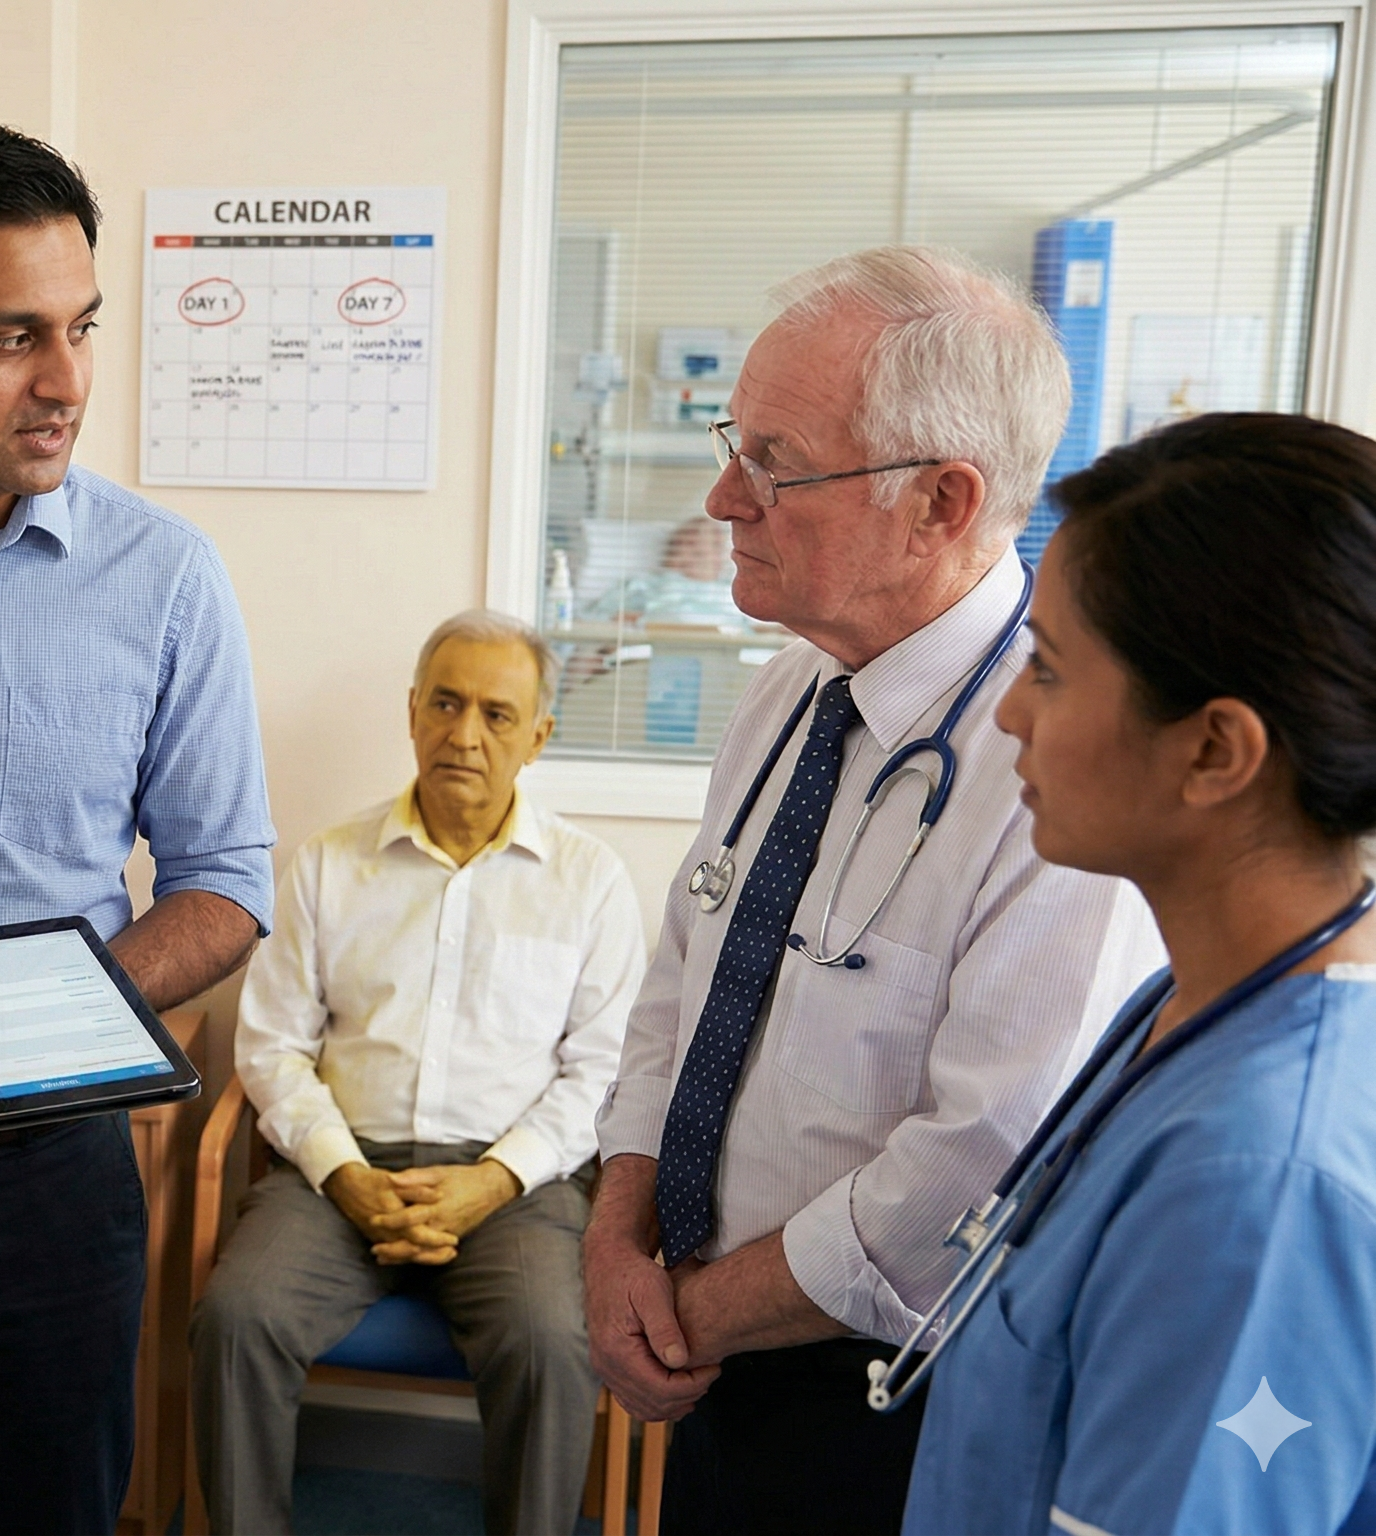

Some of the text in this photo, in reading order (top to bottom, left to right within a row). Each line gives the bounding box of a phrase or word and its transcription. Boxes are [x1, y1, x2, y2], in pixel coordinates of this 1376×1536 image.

[214, 200, 372, 224] CALENDAR
[183, 296, 230, 312] DAY 1
[344, 296, 394, 311] DAY 7
